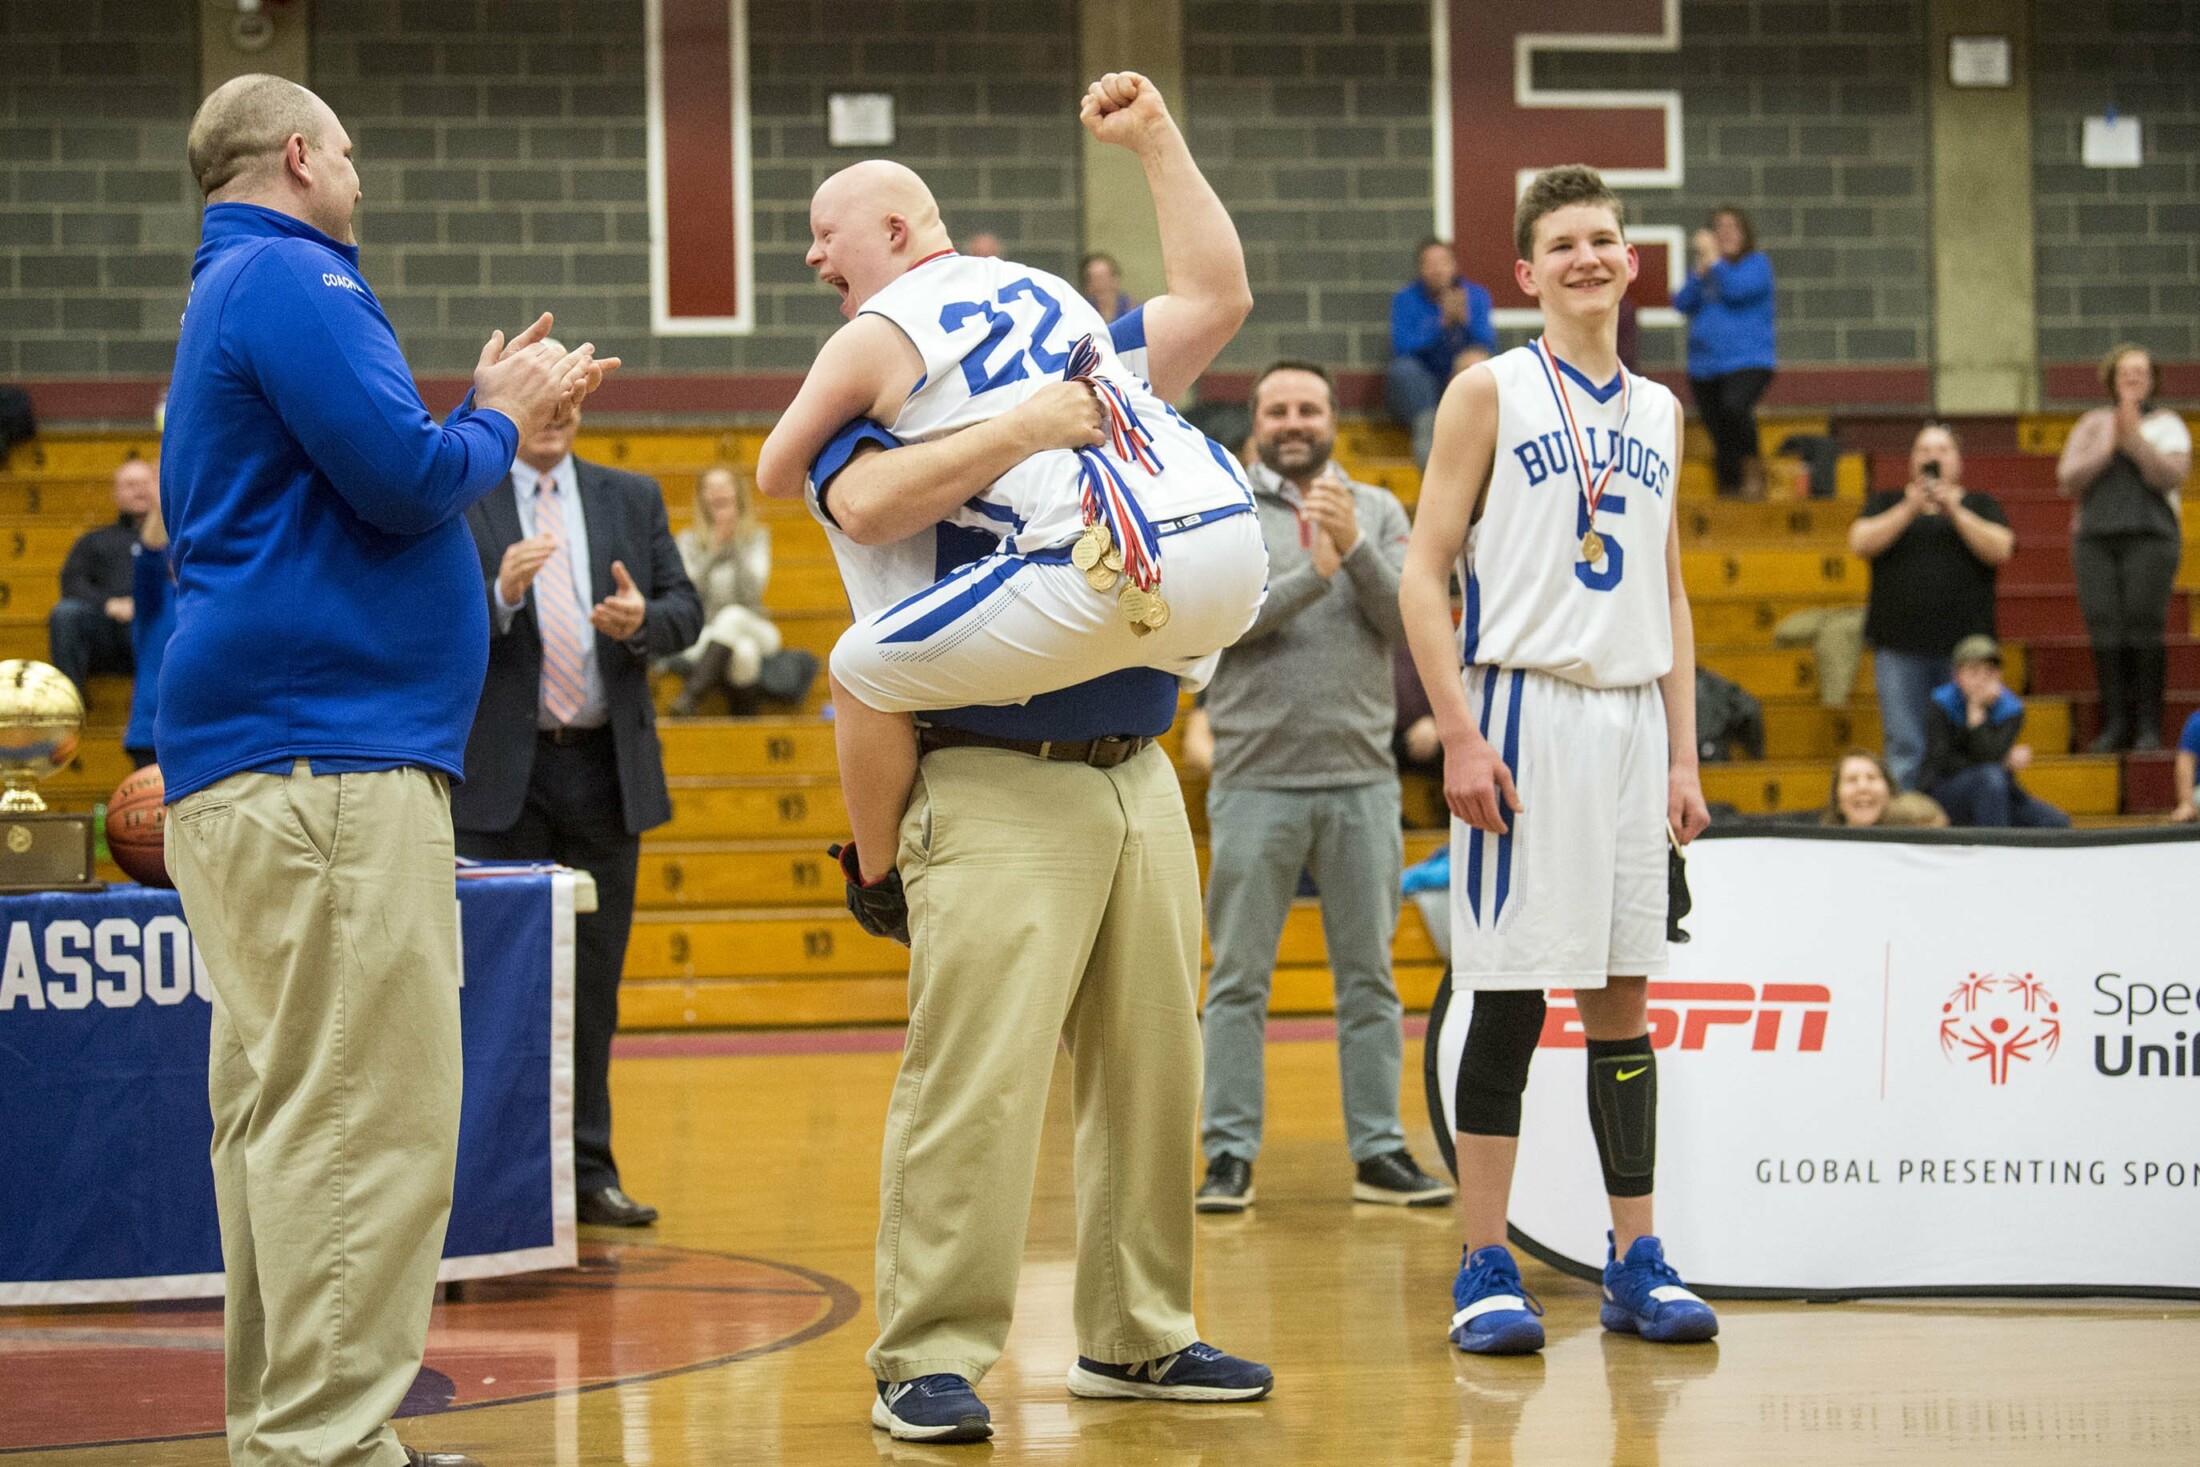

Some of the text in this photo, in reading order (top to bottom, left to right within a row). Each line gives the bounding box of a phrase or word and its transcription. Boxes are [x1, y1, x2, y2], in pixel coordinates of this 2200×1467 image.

[939, 278, 1073, 396] 22
[1513, 427, 1669, 498] BULDOGS
[1575, 490, 1626, 591] 5
[0, 915, 212, 1010] ASSO
[2093, 973, 2200, 1026] Spe
[1756, 1158, 1880, 1184] GLOBAL
[1899, 1159, 2105, 1186] PRESENTING
